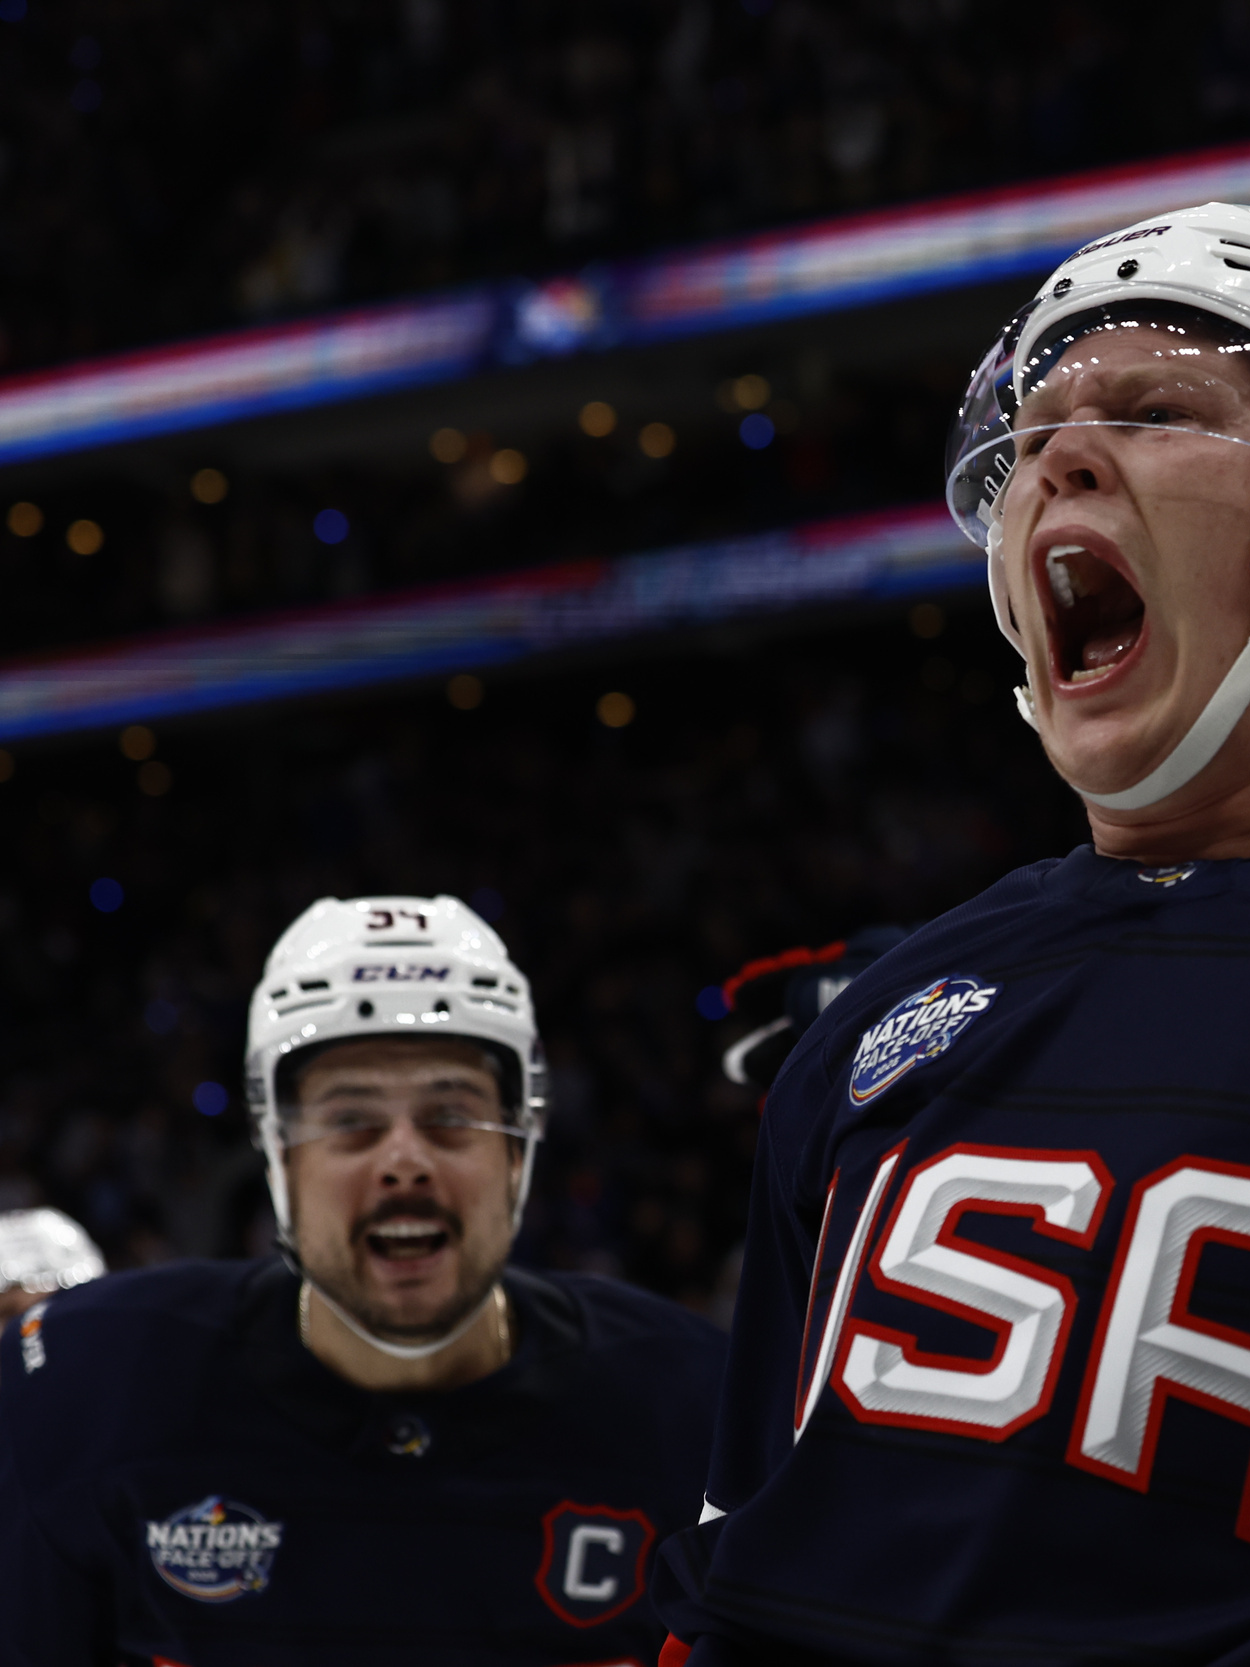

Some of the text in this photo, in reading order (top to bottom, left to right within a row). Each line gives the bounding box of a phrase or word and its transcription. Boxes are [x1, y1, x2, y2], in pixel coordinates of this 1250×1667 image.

[853, 987, 998, 1065] NATIONS
[854, 1014, 965, 1081] FACE-OFF
[146, 1521, 284, 1549] NATIONS
[563, 1524, 624, 1602] C
